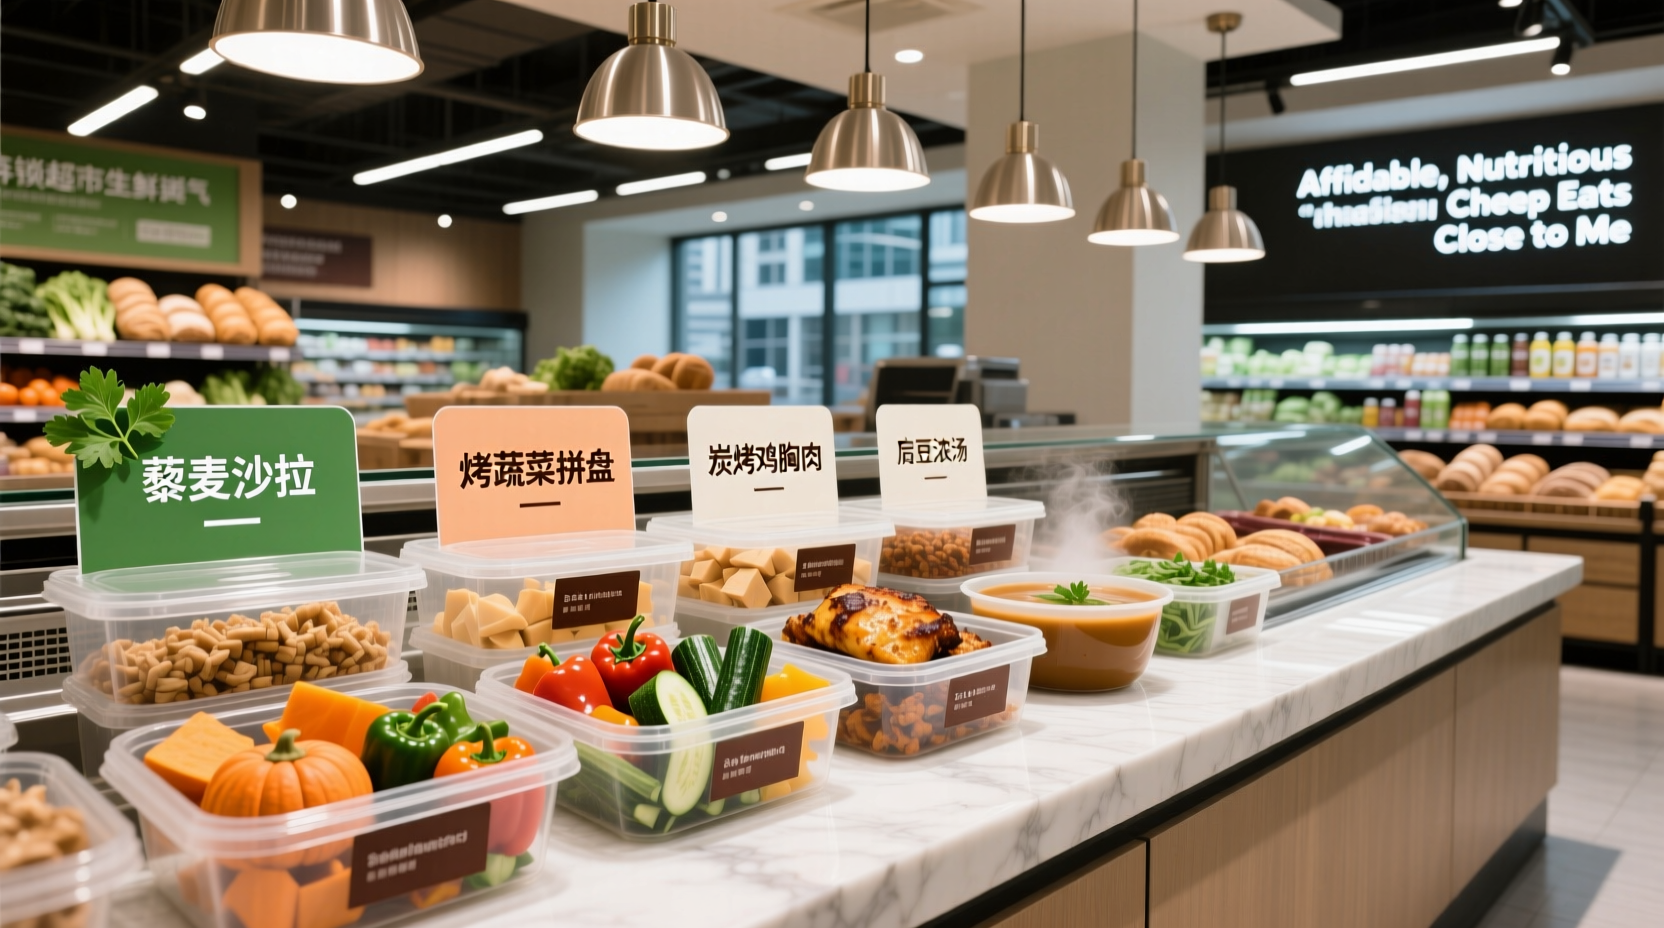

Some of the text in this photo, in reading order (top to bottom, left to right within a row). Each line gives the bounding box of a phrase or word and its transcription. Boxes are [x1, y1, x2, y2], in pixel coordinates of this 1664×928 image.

[1296, 142, 1633, 199] Affidable, Nutritious
[1557, 178, 1633, 211] Eats
[1433, 213, 1633, 255] Close to Me
[459, 448, 615, 489] 烤蔬菜拼盘
[708, 441, 822, 476] 炭烤鸡胸肉
